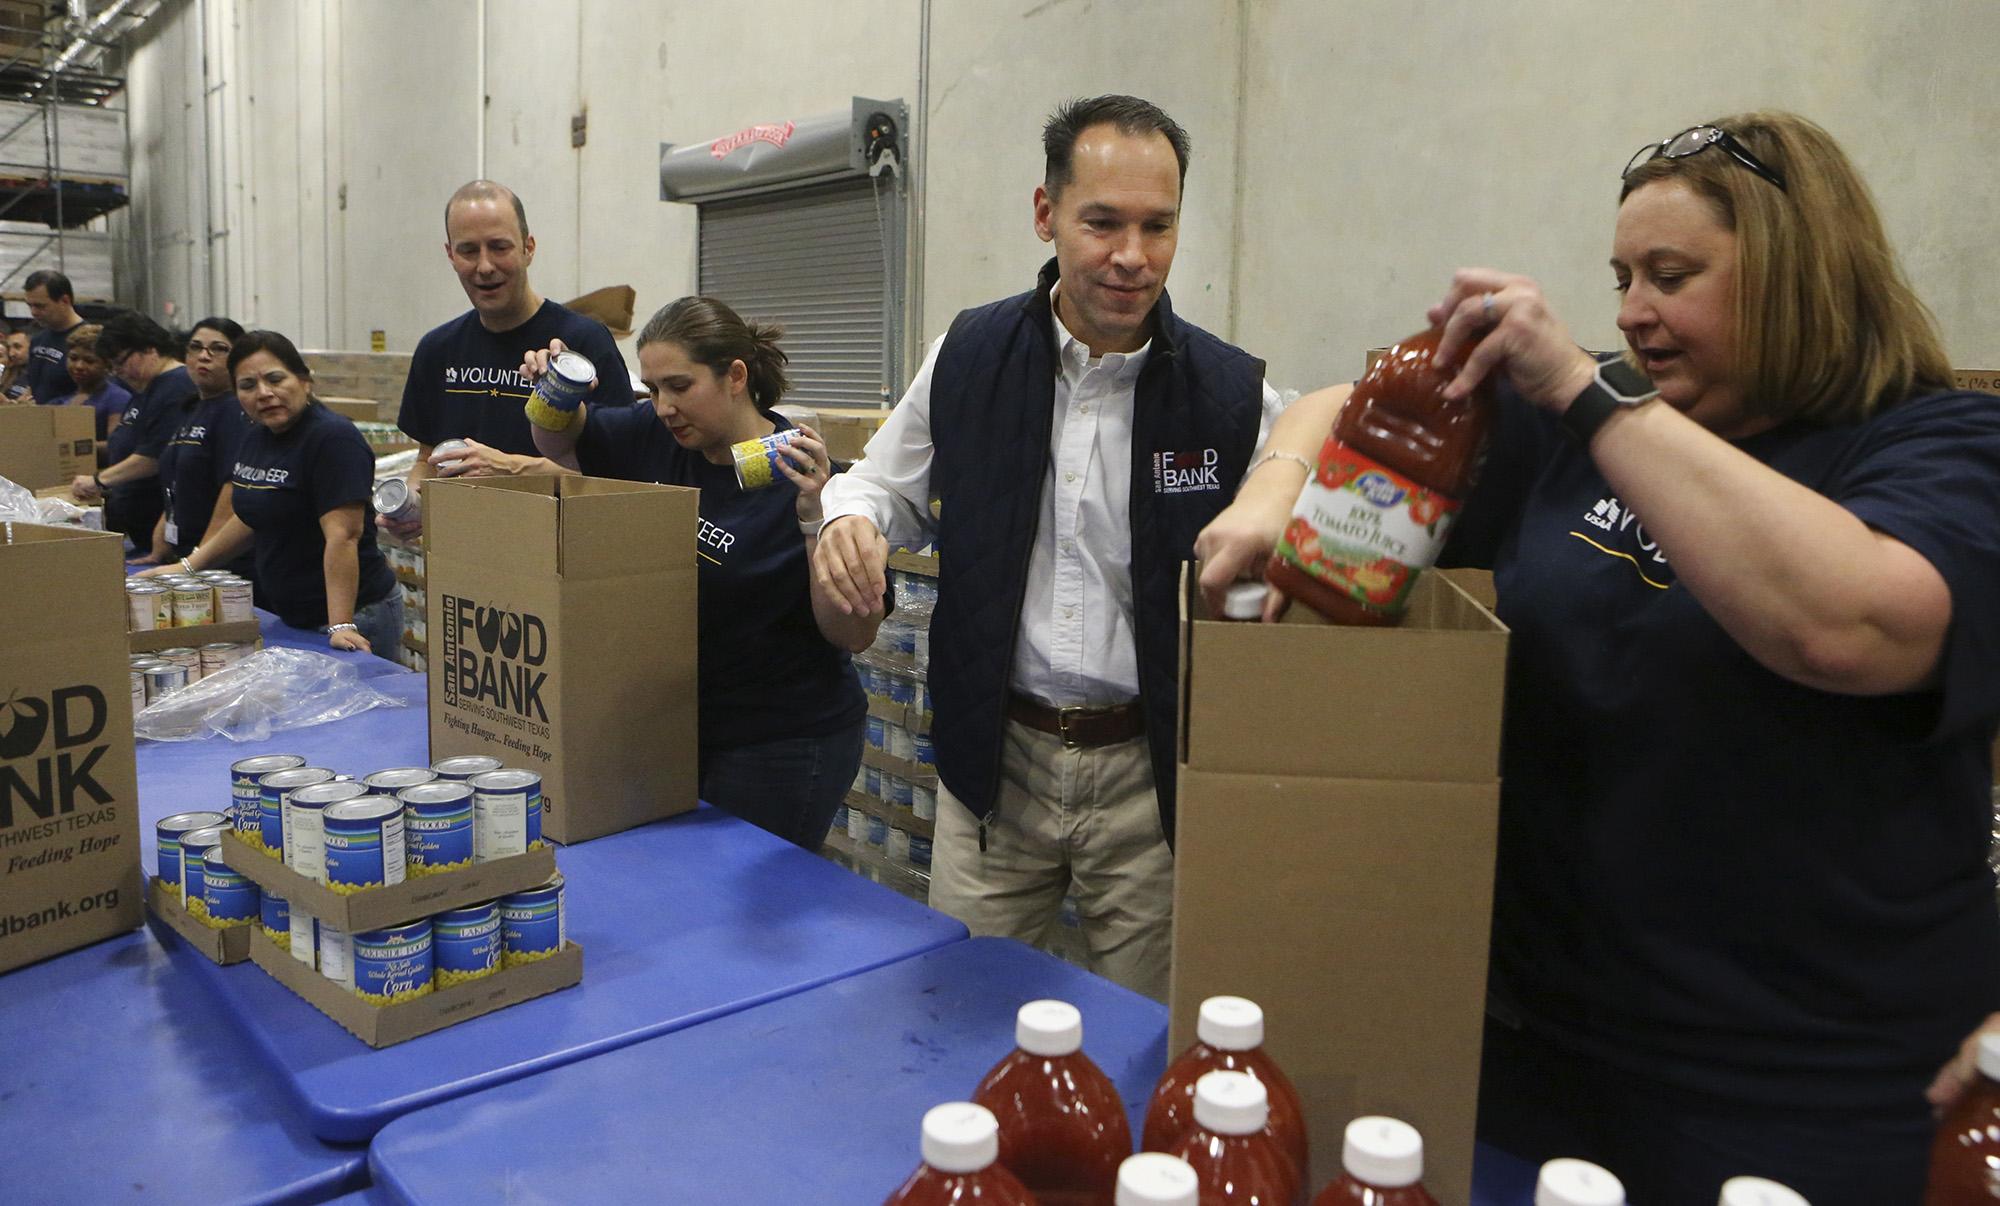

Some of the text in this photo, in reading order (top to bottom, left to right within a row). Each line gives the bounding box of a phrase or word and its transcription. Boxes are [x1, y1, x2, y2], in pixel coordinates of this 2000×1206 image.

[240, 463, 288, 483] VOLUNEER
[1163, 466, 1219, 487] BANK
[1312, 505, 1369, 540] TOMATO
[1584, 512, 1612, 532] USAA
[457, 598, 547, 667] FOOD
[444, 597, 456, 706] San Antonio
[459, 648, 549, 724] BANK
[444, 711, 470, 735] Fighting
[503, 733, 531, 758] Feeding
[532, 743, 552, 762] Hope
[459, 698, 550, 740] SERVING SOUTHWEST TEXAS
[66, 807, 116, 832] TEXAS
[238, 816, 260, 832] Corn
[7, 834, 120, 874] Feeding Hope
[383, 979, 414, 998] Corn
